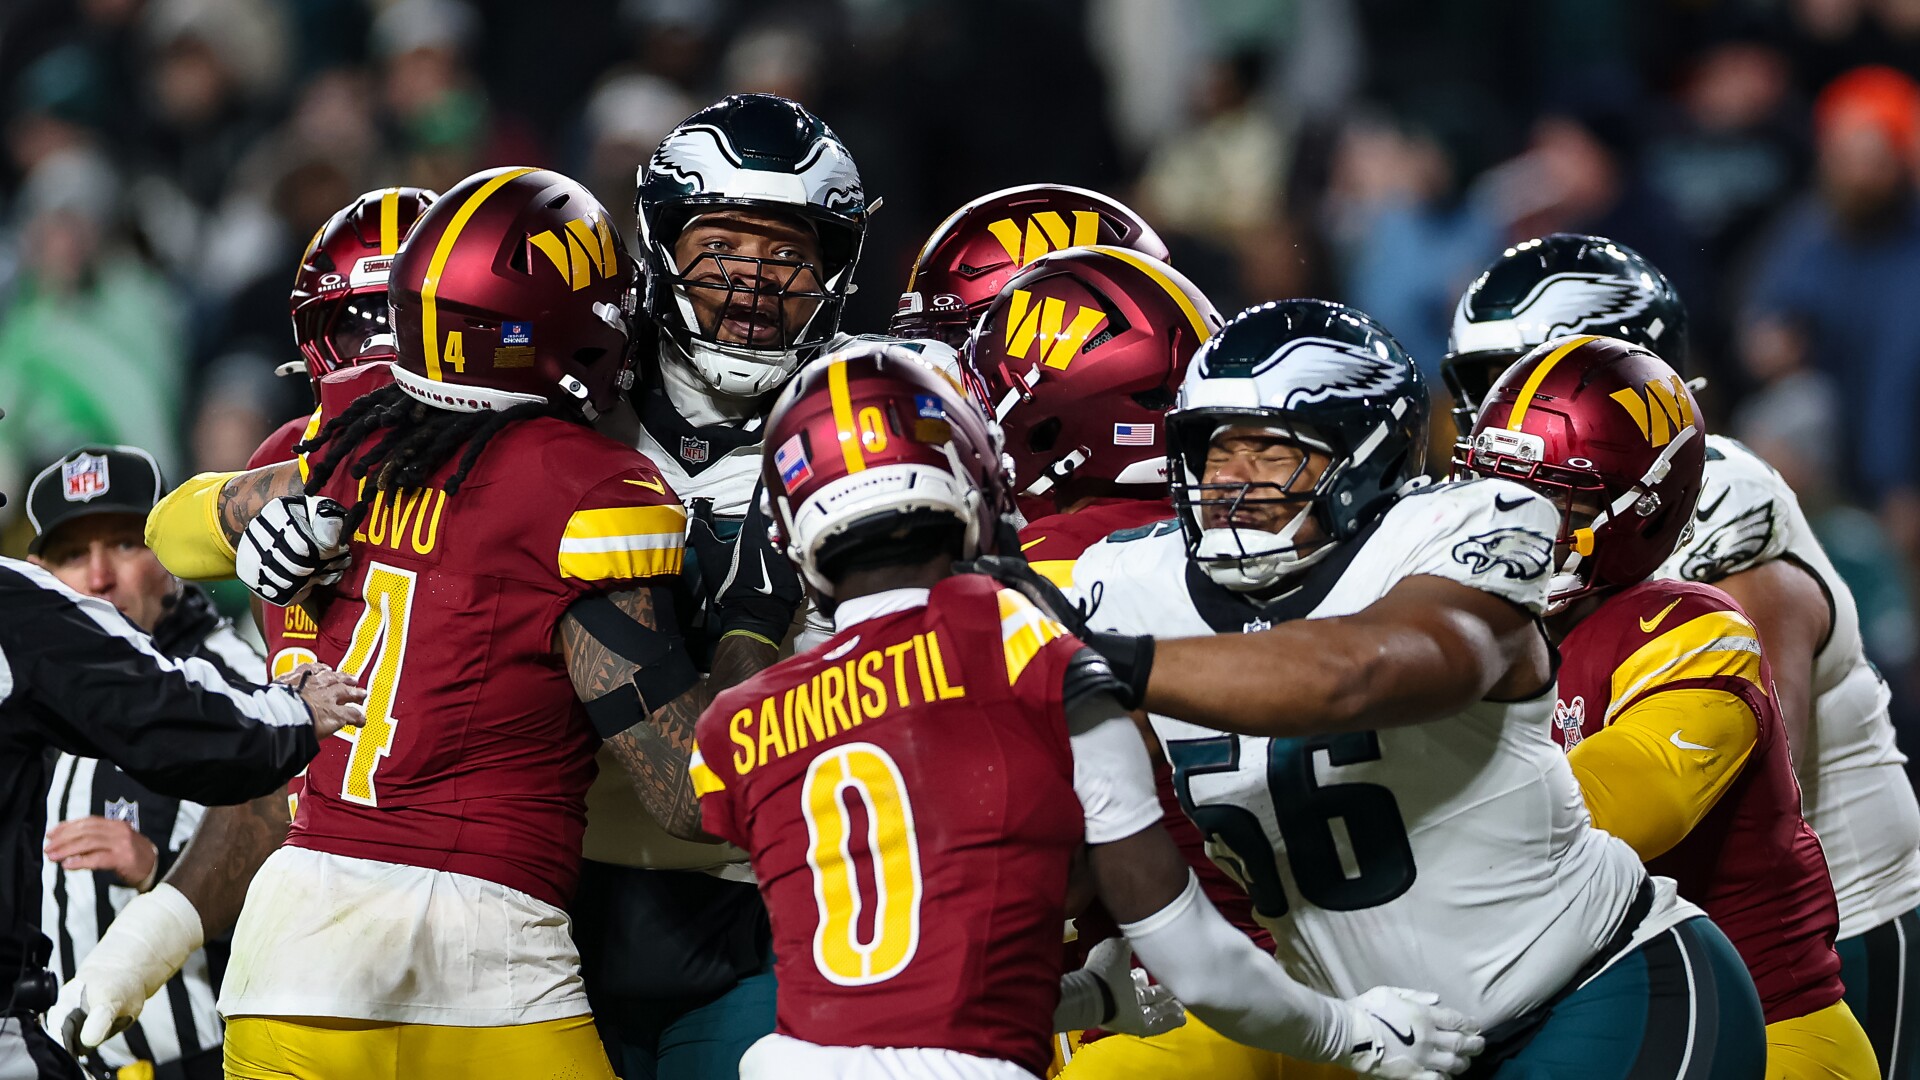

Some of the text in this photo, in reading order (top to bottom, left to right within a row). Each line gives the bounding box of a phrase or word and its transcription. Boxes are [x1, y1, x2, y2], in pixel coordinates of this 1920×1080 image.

[444, 331, 465, 373] 4
[67, 472, 105, 495] NFL
[685, 449, 704, 460] NFL
[333, 561, 417, 807] 4
[729, 631, 965, 775] SAINRISTIL
[801, 742, 923, 986] 0
[1166, 730, 1416, 912] 56
